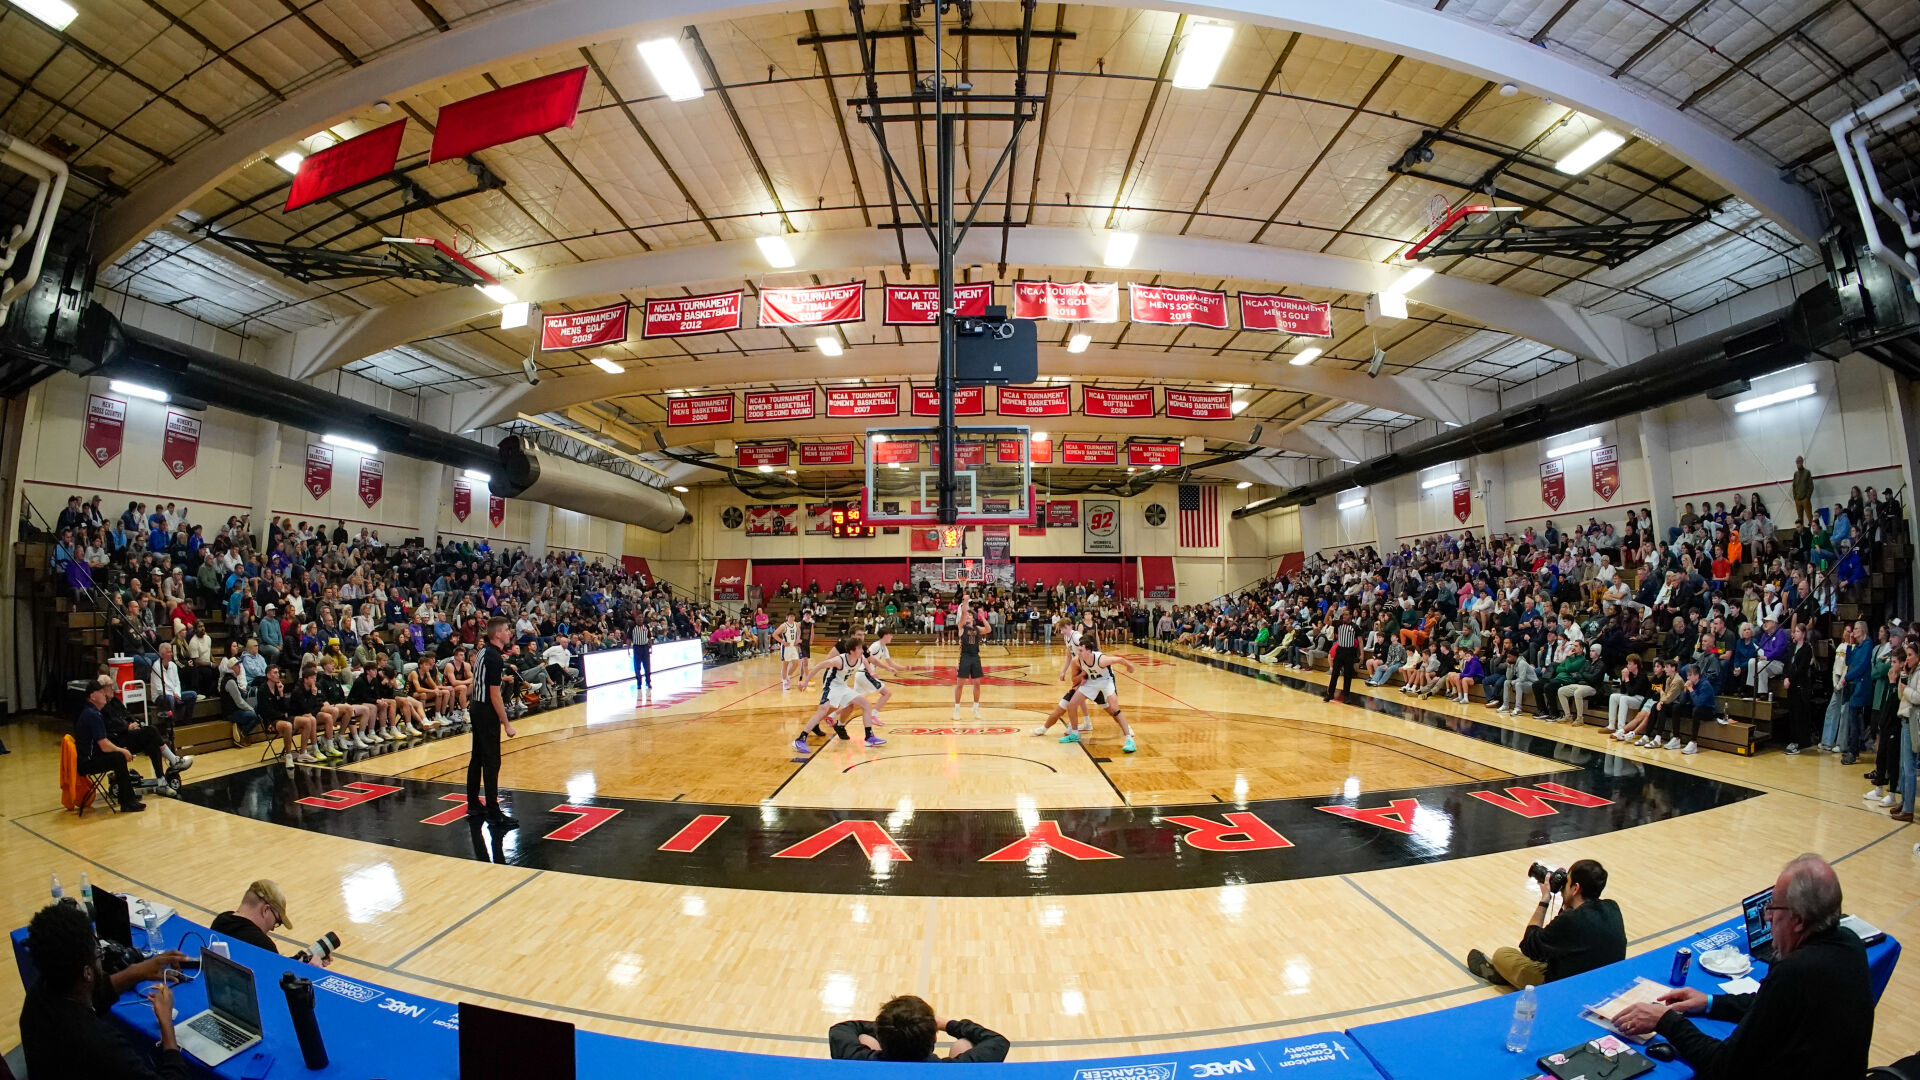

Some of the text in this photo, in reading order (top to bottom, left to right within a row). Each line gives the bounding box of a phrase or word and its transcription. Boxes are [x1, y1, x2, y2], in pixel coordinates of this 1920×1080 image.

[796, 289, 855, 302] TOURNAMENT
[894, 289, 983, 301] NCAA TOUAMENT
[1020, 287, 1045, 295] NCAA
[1136, 290, 1220, 305] NCAA TOURNAMENT
[654, 297, 733, 312] NCAA TOURNAMENT
[912, 301, 938, 310] MEN'S
[1150, 301, 1208, 313] MEN'S SOCCER
[1246, 300, 1325, 313] NCAA TOURNAMENT
[548, 310, 621, 328] NCAA TOURNAMENT
[649, 305, 737, 322] WOMEN'S BASKETBALL
[1169, 312, 1191, 320] 2018
[1264, 309, 1309, 321] MEN'S GOLF
[586, 322, 606, 333] GOLF
[680, 321, 702, 330] 2012
[1279, 320, 1297, 328] 2019
[572, 334, 592, 344] 2009
[769, 394, 809, 403] TOURNAMENT
[852, 391, 892, 399] TOURNAMENT
[691, 399, 728, 408] TOURNAMENT
[692, 406, 728, 414] BASKETBALL
[774, 401, 810, 409] BASKETBALL
[1090, 511, 1113, 530] 92
[294, 781, 1614, 862] MARYVILLE
[320, 981, 363, 1000] COACHES
[326, 977, 361, 992] CANCER
[377, 997, 426, 1018] NABC
[1283, 1042, 1327, 1056] Society
[1289, 1047, 1335, 1060] Cancer
[1279, 1053, 1336, 1068] American
[1082, 1066, 1148, 1079] CANCER
[1189, 1058, 1257, 1078] NABC
